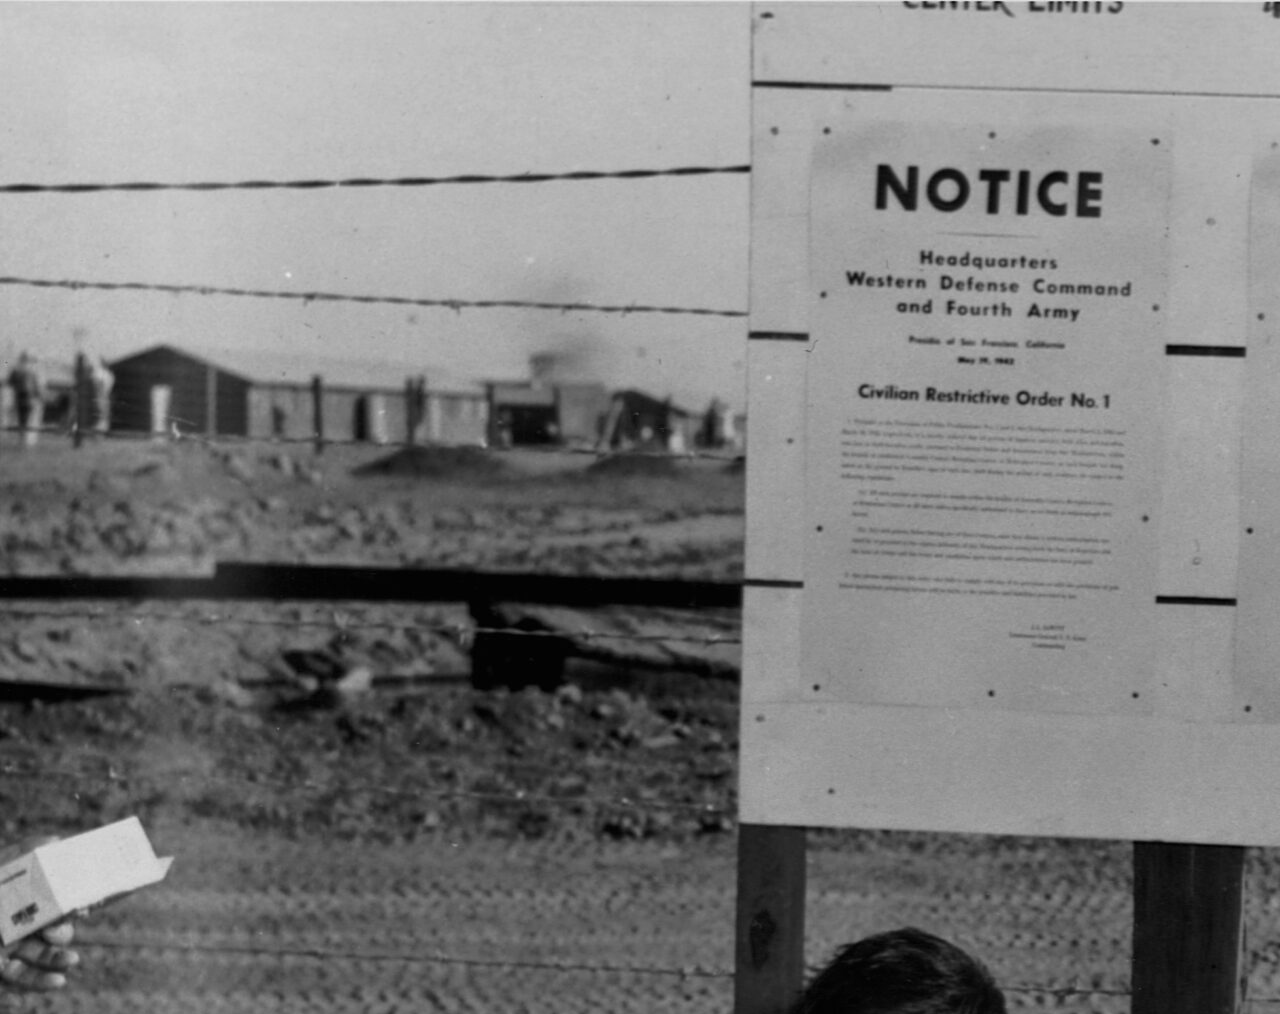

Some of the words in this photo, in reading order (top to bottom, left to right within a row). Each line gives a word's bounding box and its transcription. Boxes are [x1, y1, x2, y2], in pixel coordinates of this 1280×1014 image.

[875, 164, 1103, 218] NOTICE
[919, 250, 1058, 270] Headquarters
[846, 270, 926, 289] Western
[940, 275, 1019, 294] Defense
[1033, 278, 1132, 297] Command
[896, 299, 932, 314] and
[946, 300, 1012, 317] Fourth
[1027, 303, 1080, 322] Army
[908, 335, 941, 345] Presidio
[960, 338, 976, 346] San
[1025, 340, 1066, 350] California
[957, 356, 976, 366] May
[994, 357, 1016, 366] 1942
[858, 383, 920, 402] Civilian
[925, 387, 1010, 405] Restrictive
[1016, 390, 1064, 407] Order
[1071, 393, 1099, 409] No.
[1103, 394, 1111, 409] 1
